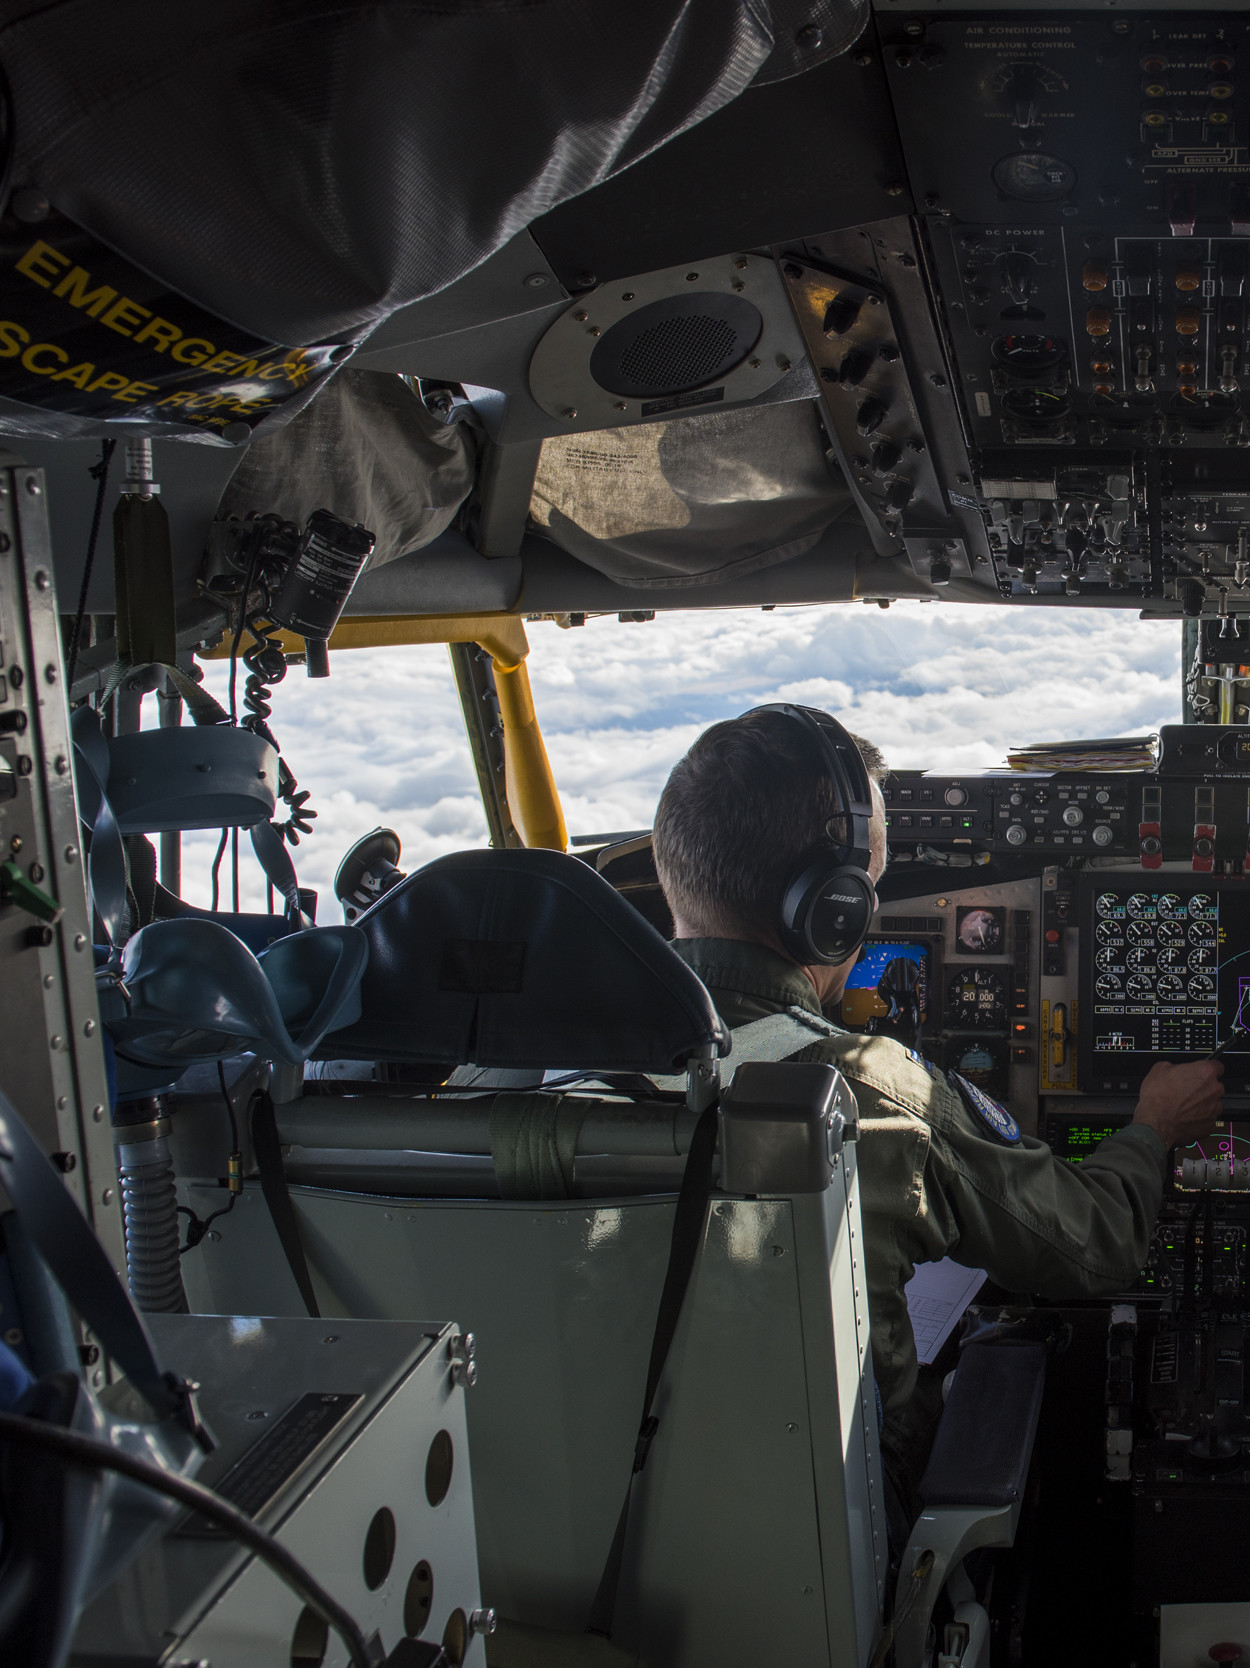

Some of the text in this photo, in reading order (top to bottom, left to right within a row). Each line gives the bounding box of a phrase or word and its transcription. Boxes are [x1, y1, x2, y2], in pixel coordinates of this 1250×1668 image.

[988, 26, 1071, 34] CONDITIONING
[14, 240, 320, 382] EMERGENCY
[156, 391, 272, 415] ROPE
[823, 893, 863, 904] BOSE
[963, 991, 976, 1001] 20
